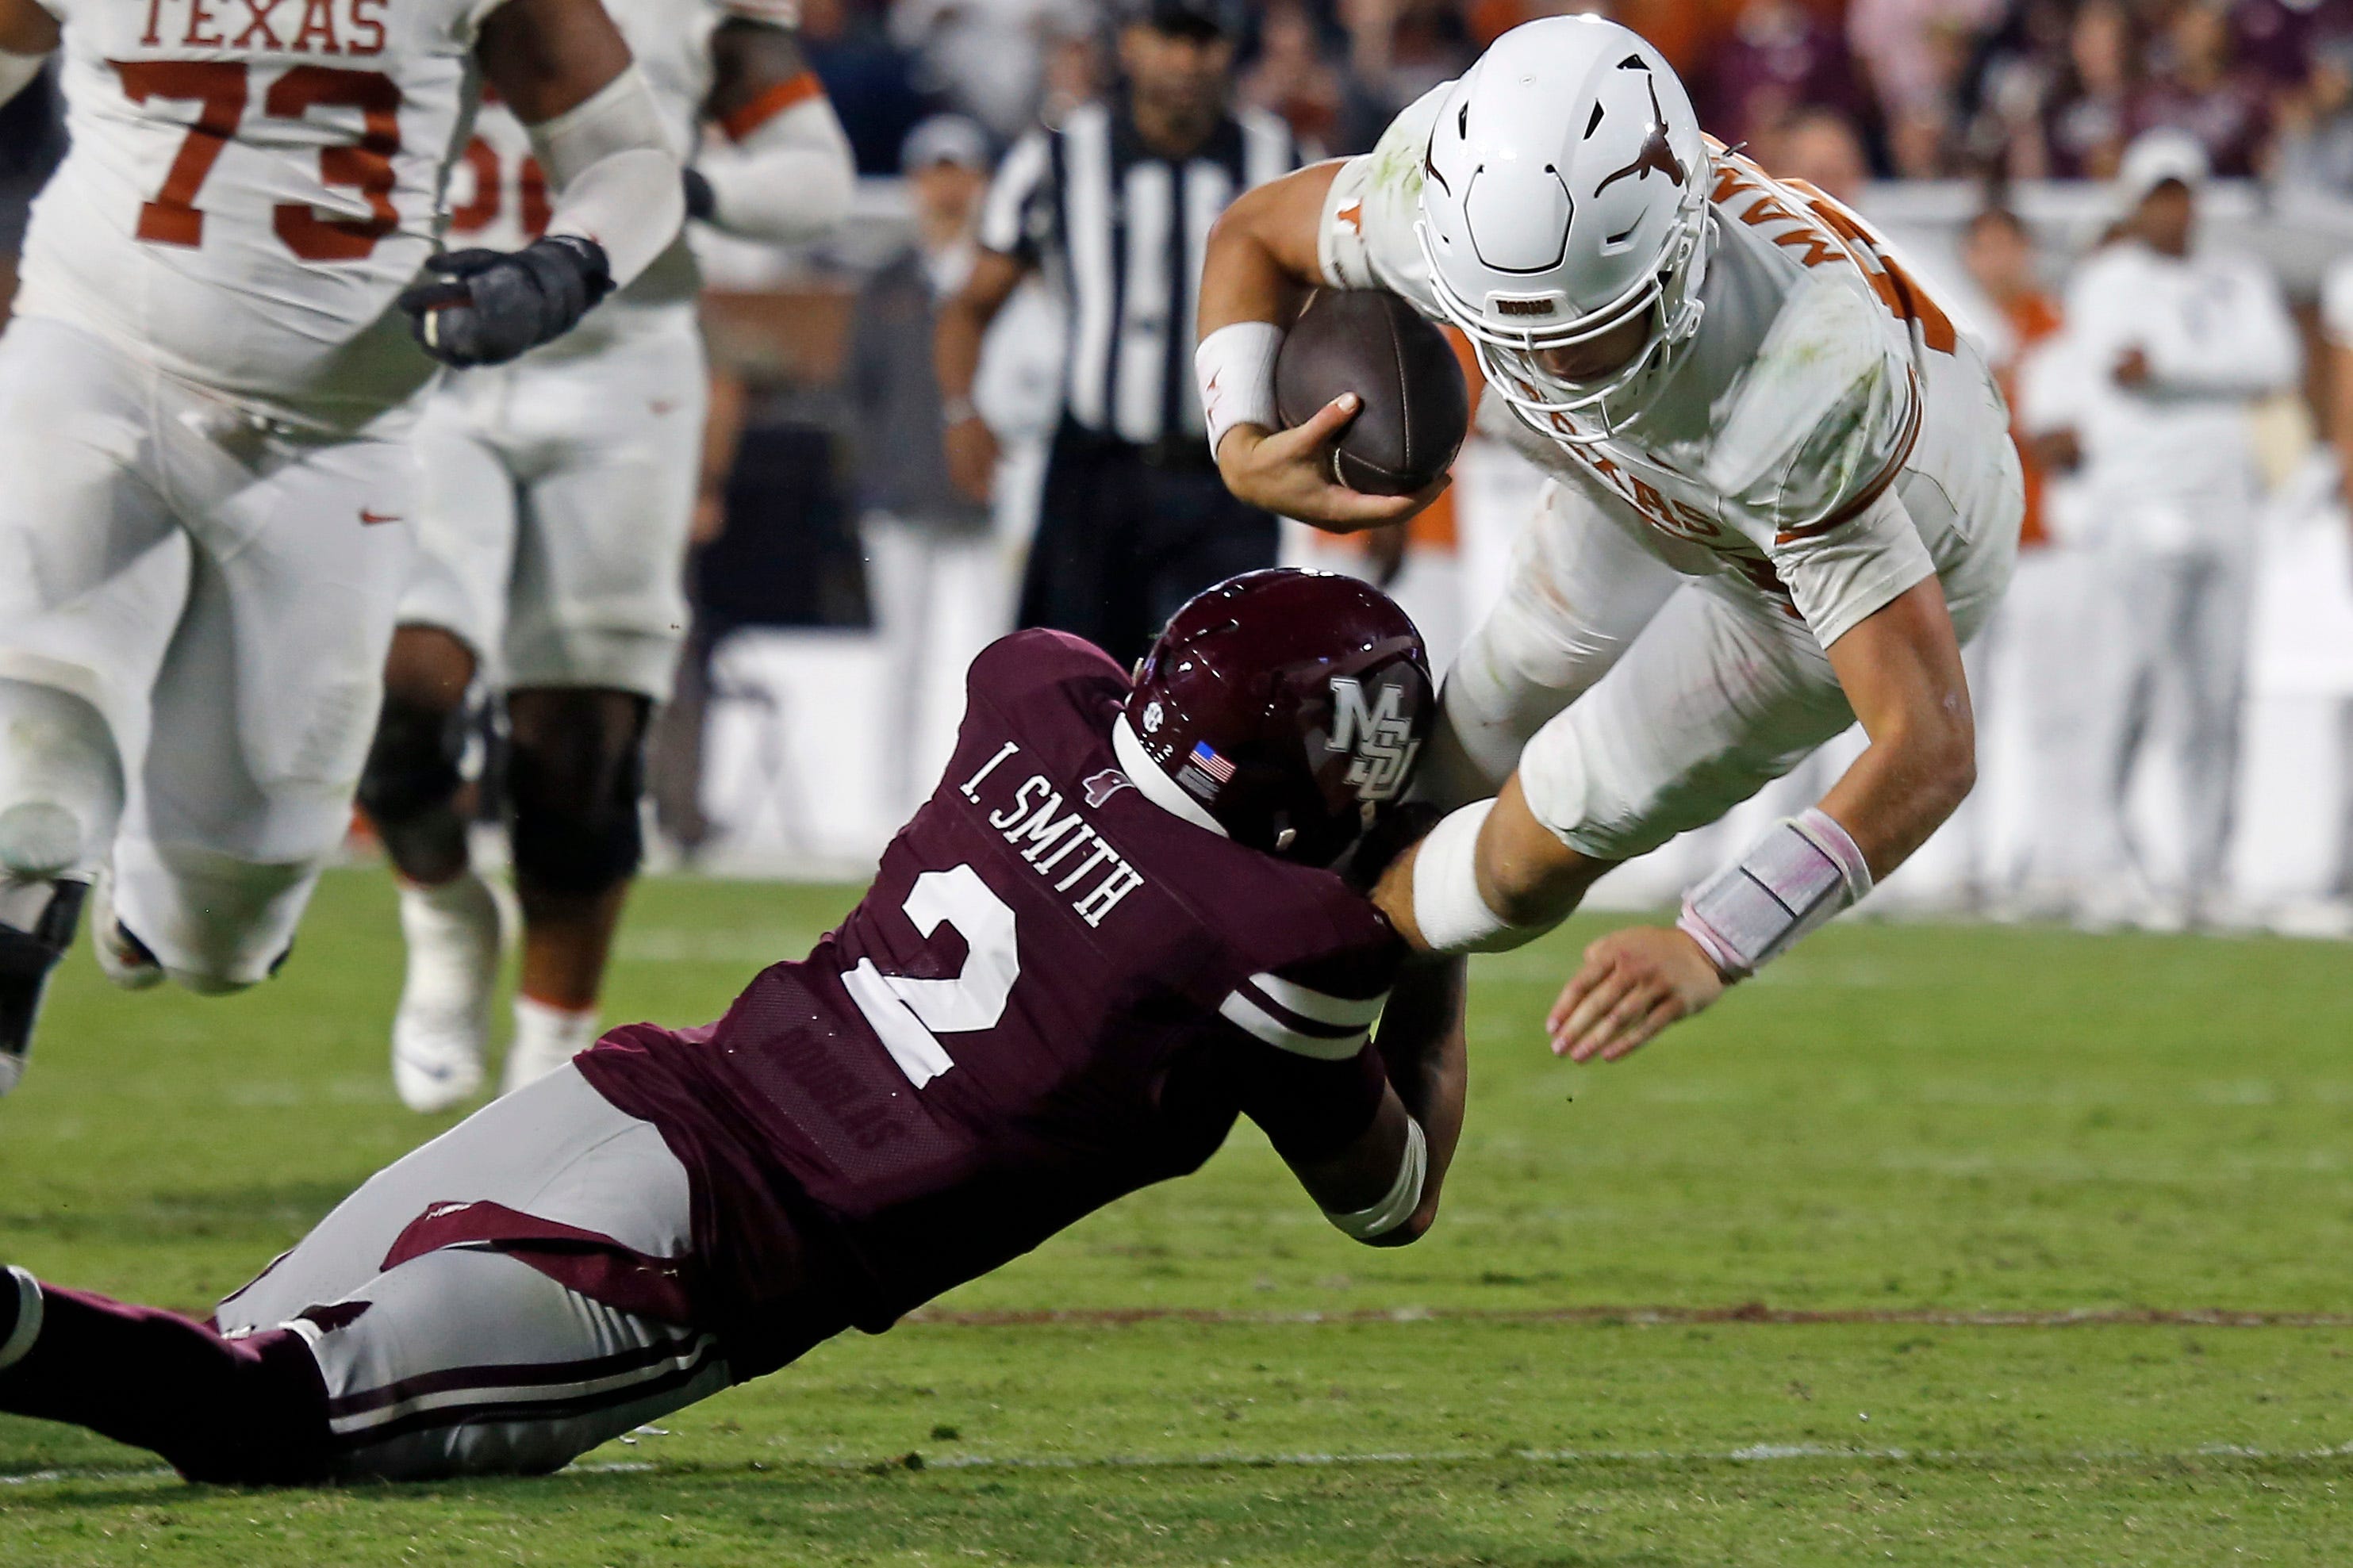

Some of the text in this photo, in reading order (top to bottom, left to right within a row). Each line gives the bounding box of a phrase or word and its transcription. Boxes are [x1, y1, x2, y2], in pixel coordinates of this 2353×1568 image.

[140, 0, 389, 56] TEXAS
[104, 58, 402, 260] 73
[1324, 677, 1422, 800] MSU
[988, 775, 1145, 928] SMITH
[840, 863, 1021, 1090] 2
